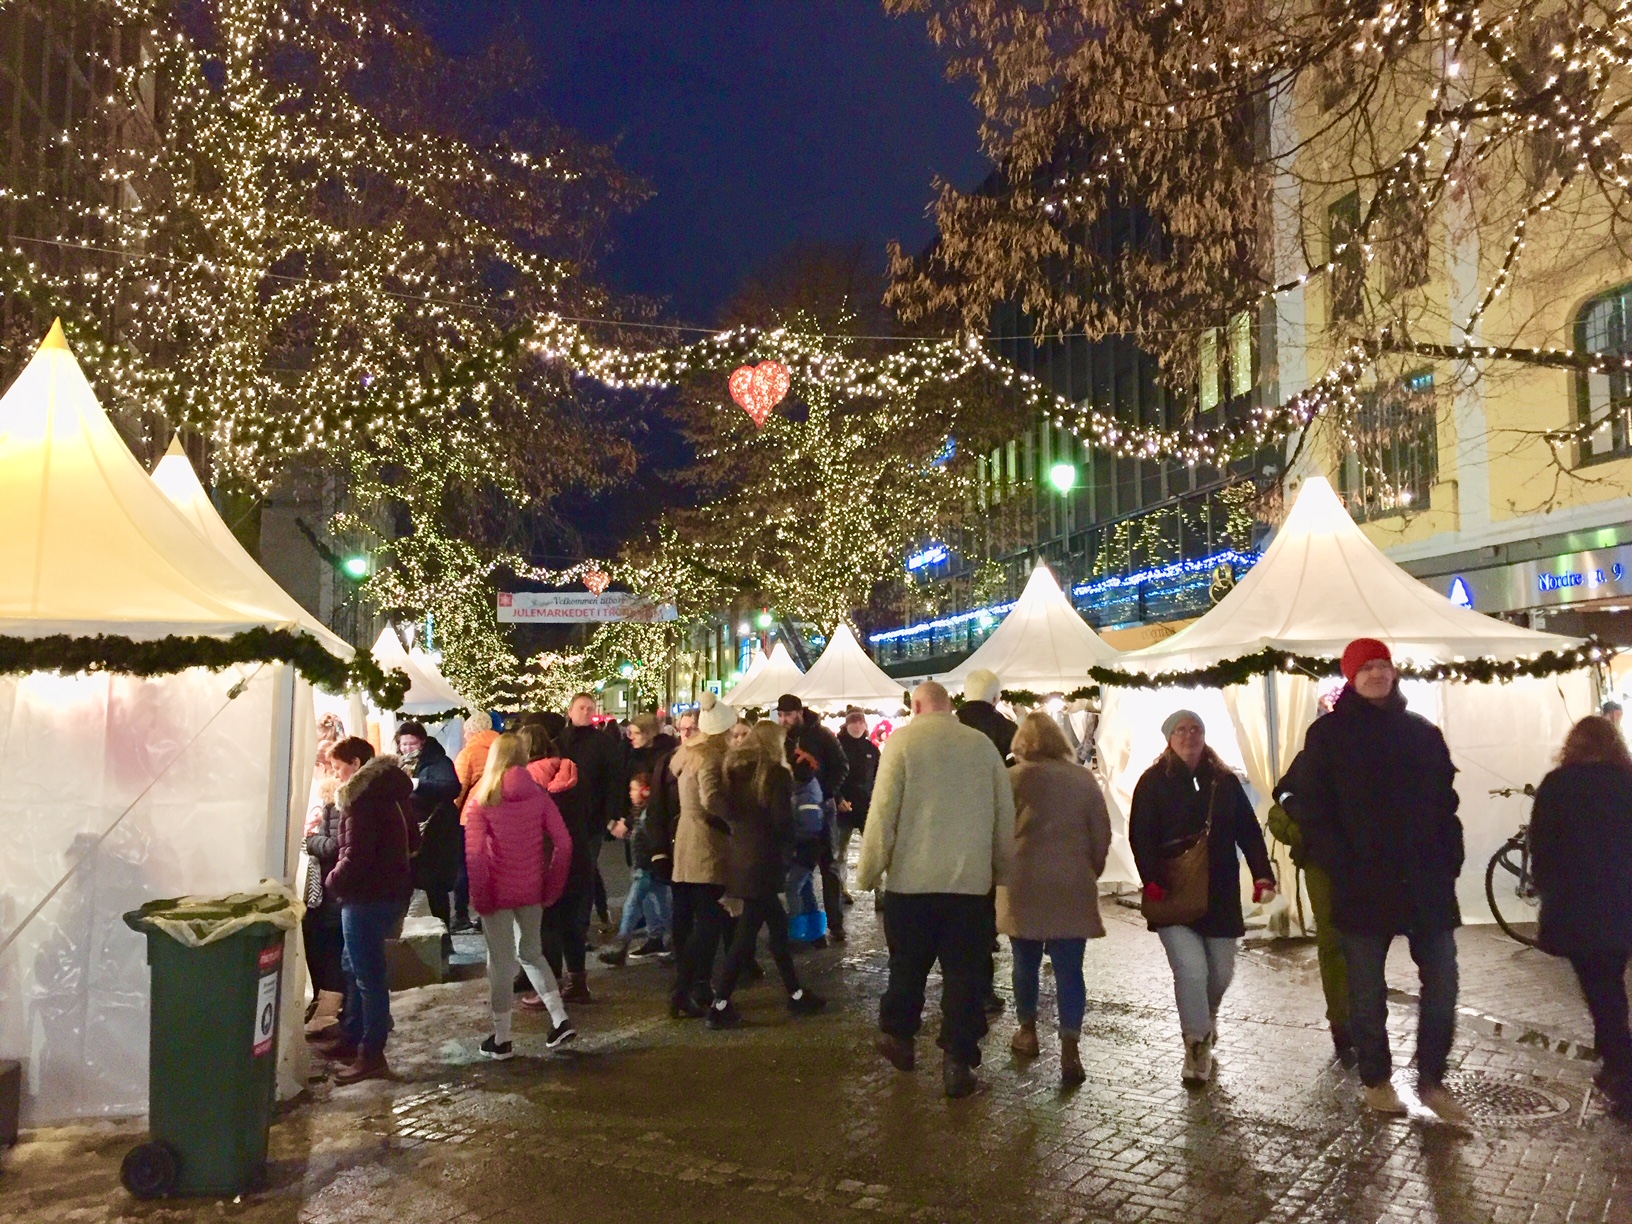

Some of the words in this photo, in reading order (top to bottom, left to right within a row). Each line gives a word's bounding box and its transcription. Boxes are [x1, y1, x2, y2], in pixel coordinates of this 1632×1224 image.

[1538, 570, 1584, 590] Nordre
[1611, 562, 1623, 582] 9
[554, 596, 598, 605] Velkommen
[512, 608, 595, 617] JULEMARKEDET
